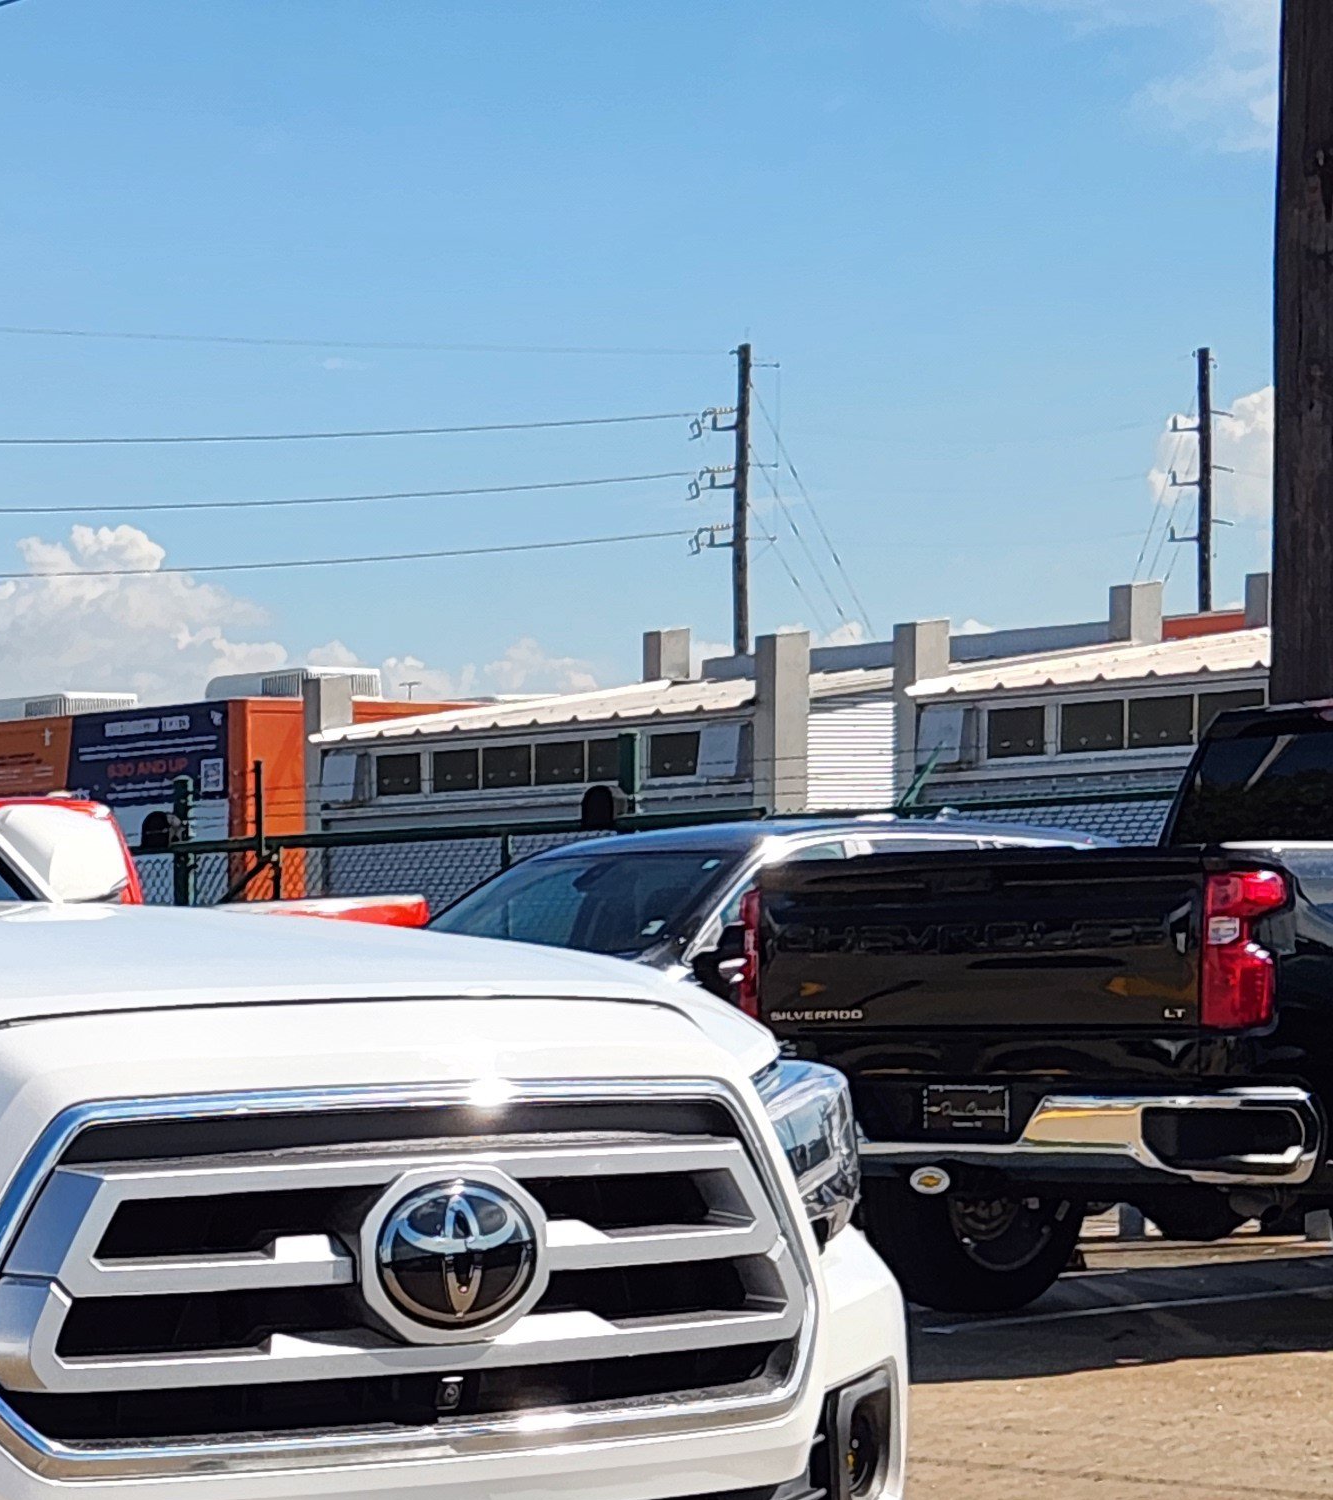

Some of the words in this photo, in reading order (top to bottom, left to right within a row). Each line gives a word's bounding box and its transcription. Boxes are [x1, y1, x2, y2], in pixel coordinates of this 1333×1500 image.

[168, 757, 189, 772] UP
[770, 1009, 863, 1021] SILVERADO
[1164, 1008, 1186, 1018] LT
